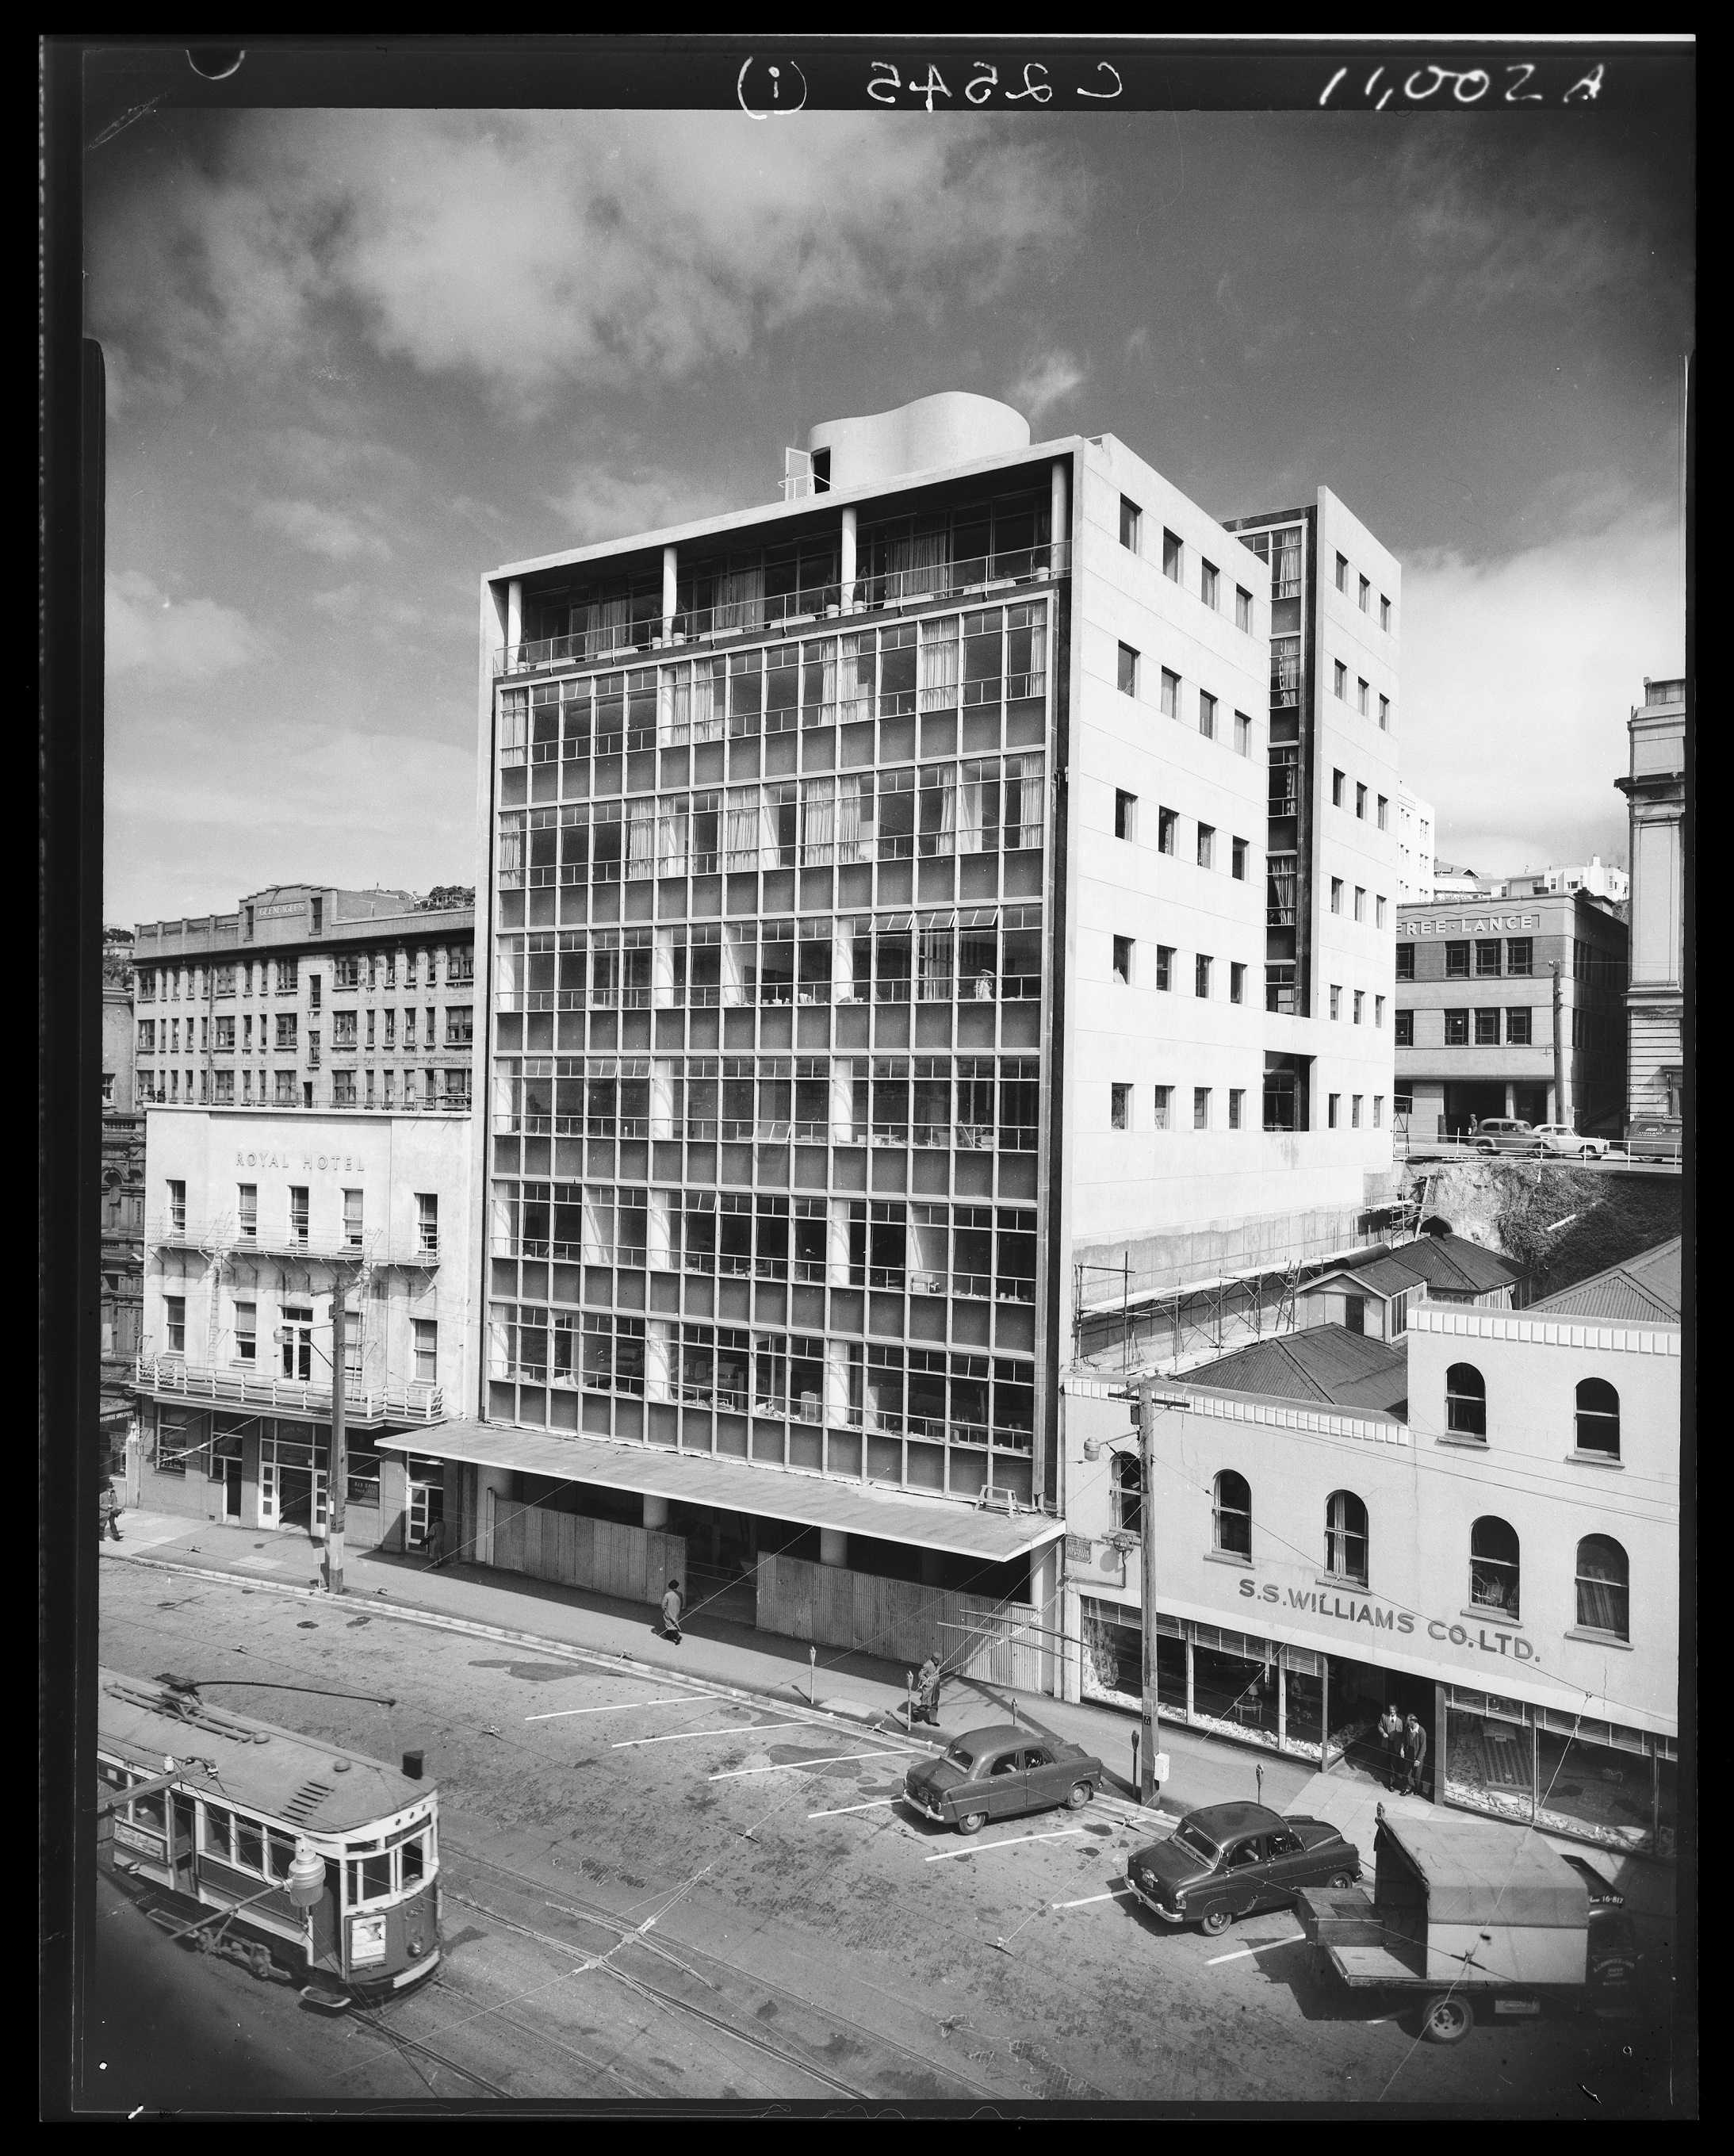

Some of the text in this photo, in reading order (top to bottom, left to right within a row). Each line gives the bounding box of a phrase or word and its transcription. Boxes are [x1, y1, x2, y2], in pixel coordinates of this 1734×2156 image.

[259, 903, 304, 916] GLENEAGLES
[1460, 915, 1532, 932] LANCE
[236, 1152, 365, 1172] ROYAL HOTEL
[1602, 1895, 1624, 1904] 16-817
